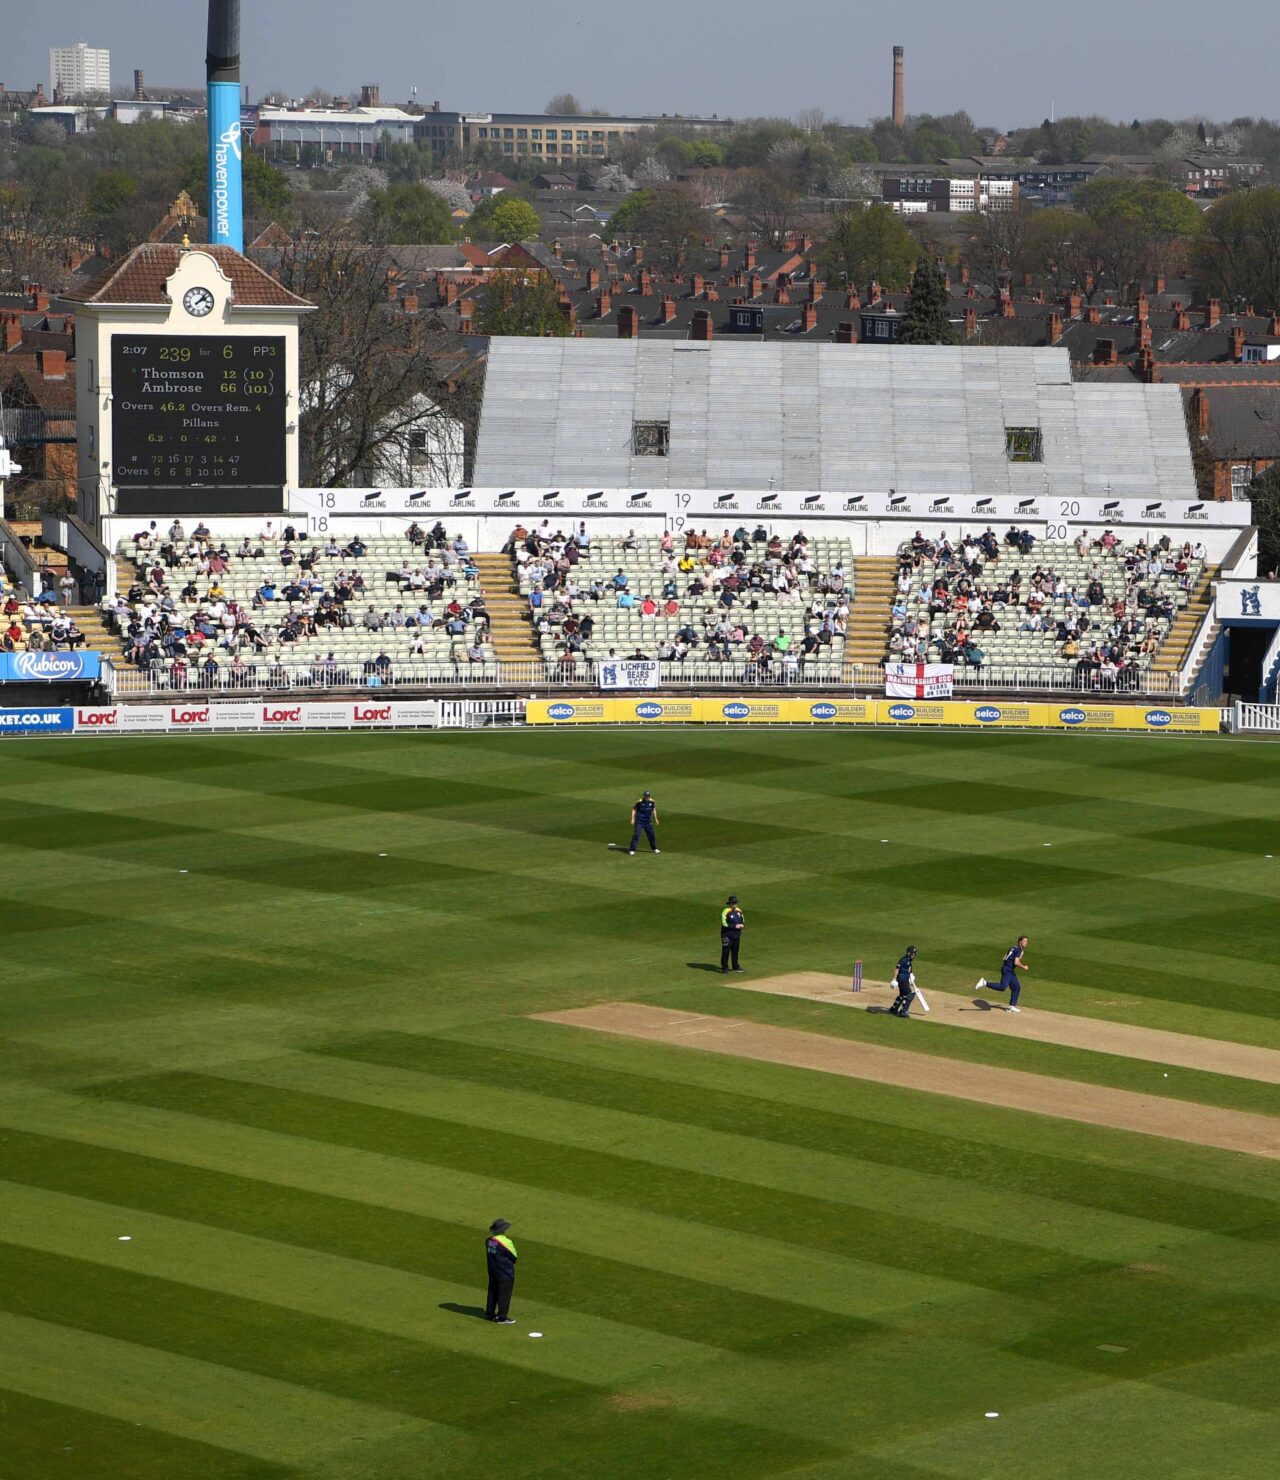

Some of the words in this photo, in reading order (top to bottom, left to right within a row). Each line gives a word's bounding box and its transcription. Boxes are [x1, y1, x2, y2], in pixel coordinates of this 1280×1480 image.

[122, 346, 147, 354] 2:07
[159, 347, 191, 362] 239
[200, 348, 211, 356] for
[223, 345, 233, 359] 6
[253, 346, 276, 357] PP3
[141, 368, 204, 379] Thomson
[223, 370, 237, 379] 12
[141, 382, 202, 393] Ambrose
[220, 383, 237, 393] 66
[243, 382, 274, 396] (101)
[121, 401, 154, 410] Overs
[160, 402, 185, 412] 46.2
[191, 403, 223, 412] Overs
[226, 403, 251, 412] Rem.
[255, 403, 261, 412] 4
[182, 418, 219, 427] Pillans
[148, 433, 164, 442] 6.2
[204, 435, 217, 443] 42
[151, 455, 163, 463] 72
[168, 454, 179, 463] 16
[184, 455, 194, 463] 17
[213, 455, 224, 463] 14
[228, 455, 240, 463] 47
[117, 467, 149, 476] Overs
[153, 468, 161, 476] 6
[169, 468, 176, 476] 6
[231, 468, 238, 476] 6
[318, 492, 336, 508] 18
[359, 500, 387, 508] CARLING
[404, 500, 431, 508] CARLING
[449, 500, 476, 508] CARLING
[493, 500, 520, 508] CARLING
[537, 500, 564, 508] CARLING
[581, 500, 608, 508] CARLING
[625, 500, 652, 509] CARLING
[675, 493, 691, 508] 19
[712, 501, 739, 510] CARLING
[756, 502, 782, 511] CARLING
[799, 503, 825, 511] CARLING
[842, 503, 869, 512] CARLING
[885, 504, 912, 513] CARLING
[928, 505, 954, 514] CARLING
[1060, 500, 1080, 516] 20
[971, 506, 997, 515] CARLING
[1013, 507, 1040, 515] CARLING
[1098, 510, 1125, 518] CARLING
[1141, 511, 1167, 519] CARLING
[1183, 512, 1209, 520] CARLING
[310, 516, 328, 532] 18
[668, 516, 685, 532] 19
[1047, 524, 1067, 540] 20
[19, 652, 78, 674] Rubicon
[621, 662, 656, 671] LICHFIELD
[627, 671, 649, 679] BEARS
[548, 707, 574, 715] selco
[636, 706, 662, 714] selco
[723, 706, 749, 715] selco
[811, 707, 836, 715] selco
[889, 708, 914, 716] selco
[975, 710, 1000, 718] selco
[1060, 712, 1085, 720] selco
[1146, 714, 1171, 722] selco
